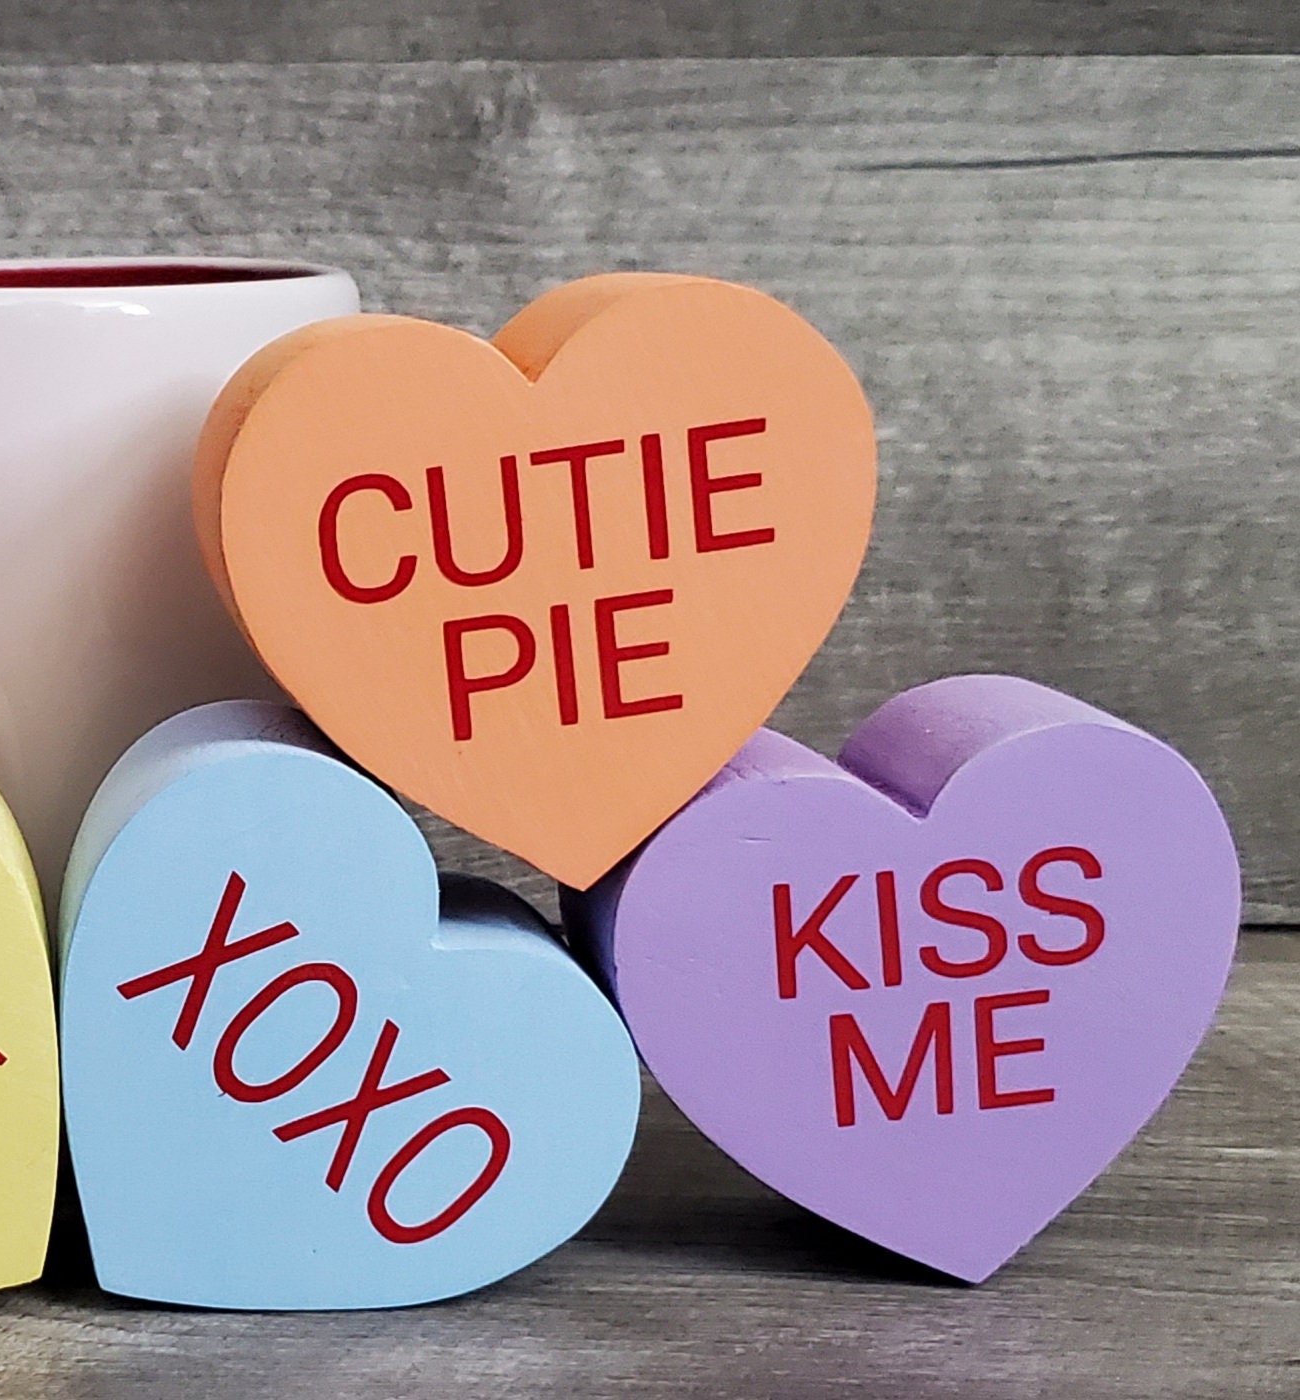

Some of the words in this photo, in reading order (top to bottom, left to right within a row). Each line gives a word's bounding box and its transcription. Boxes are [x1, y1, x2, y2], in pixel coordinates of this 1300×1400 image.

[318, 418, 776, 605] CUTIE
[443, 589, 684, 742] PIE
[773, 847, 1105, 999] KISS
[119, 873, 511, 1244] XOXO
[830, 990, 1055, 1127] ME
